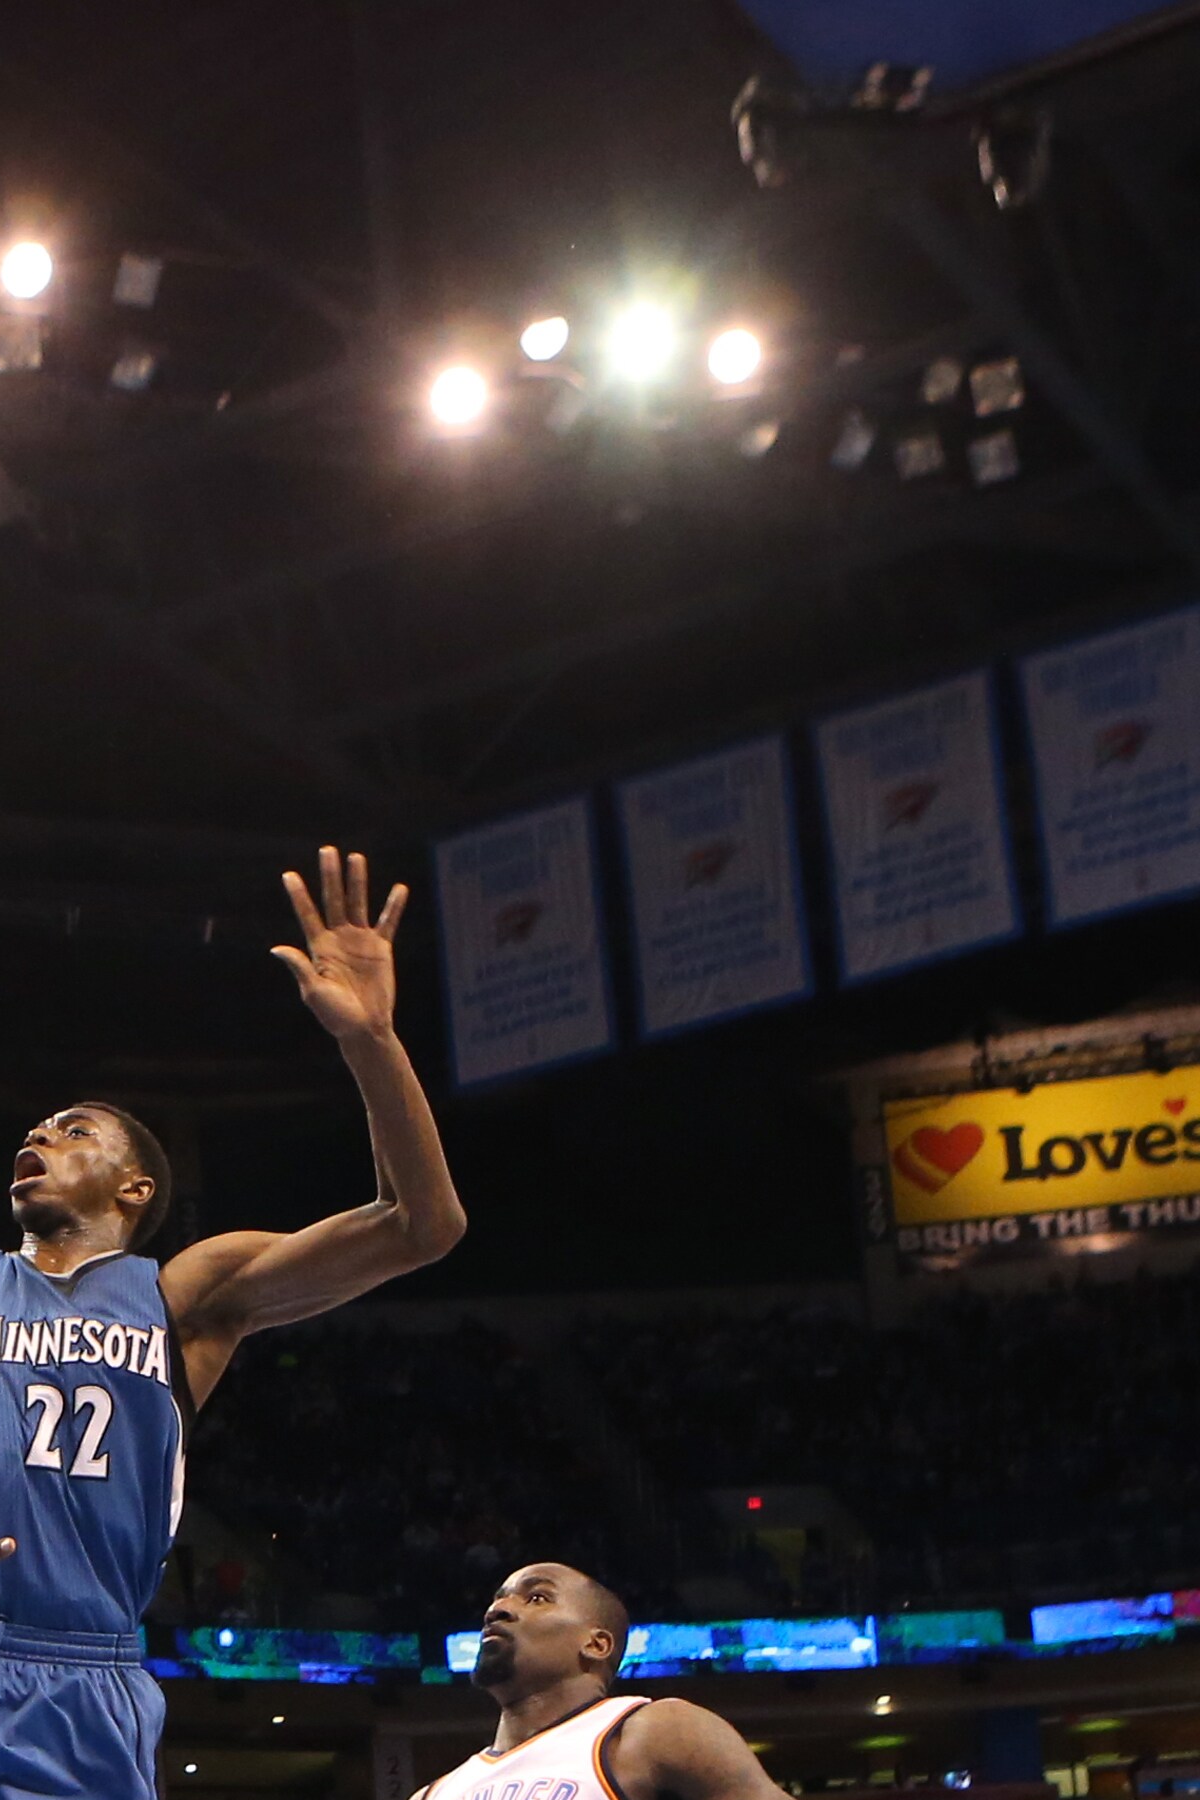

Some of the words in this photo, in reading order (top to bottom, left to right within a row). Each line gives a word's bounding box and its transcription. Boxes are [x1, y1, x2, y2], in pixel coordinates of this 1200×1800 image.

[899, 1218, 1020, 1251] BRING
[1029, 1205, 1109, 1239] THE
[25, 1382, 109, 1480] 22
